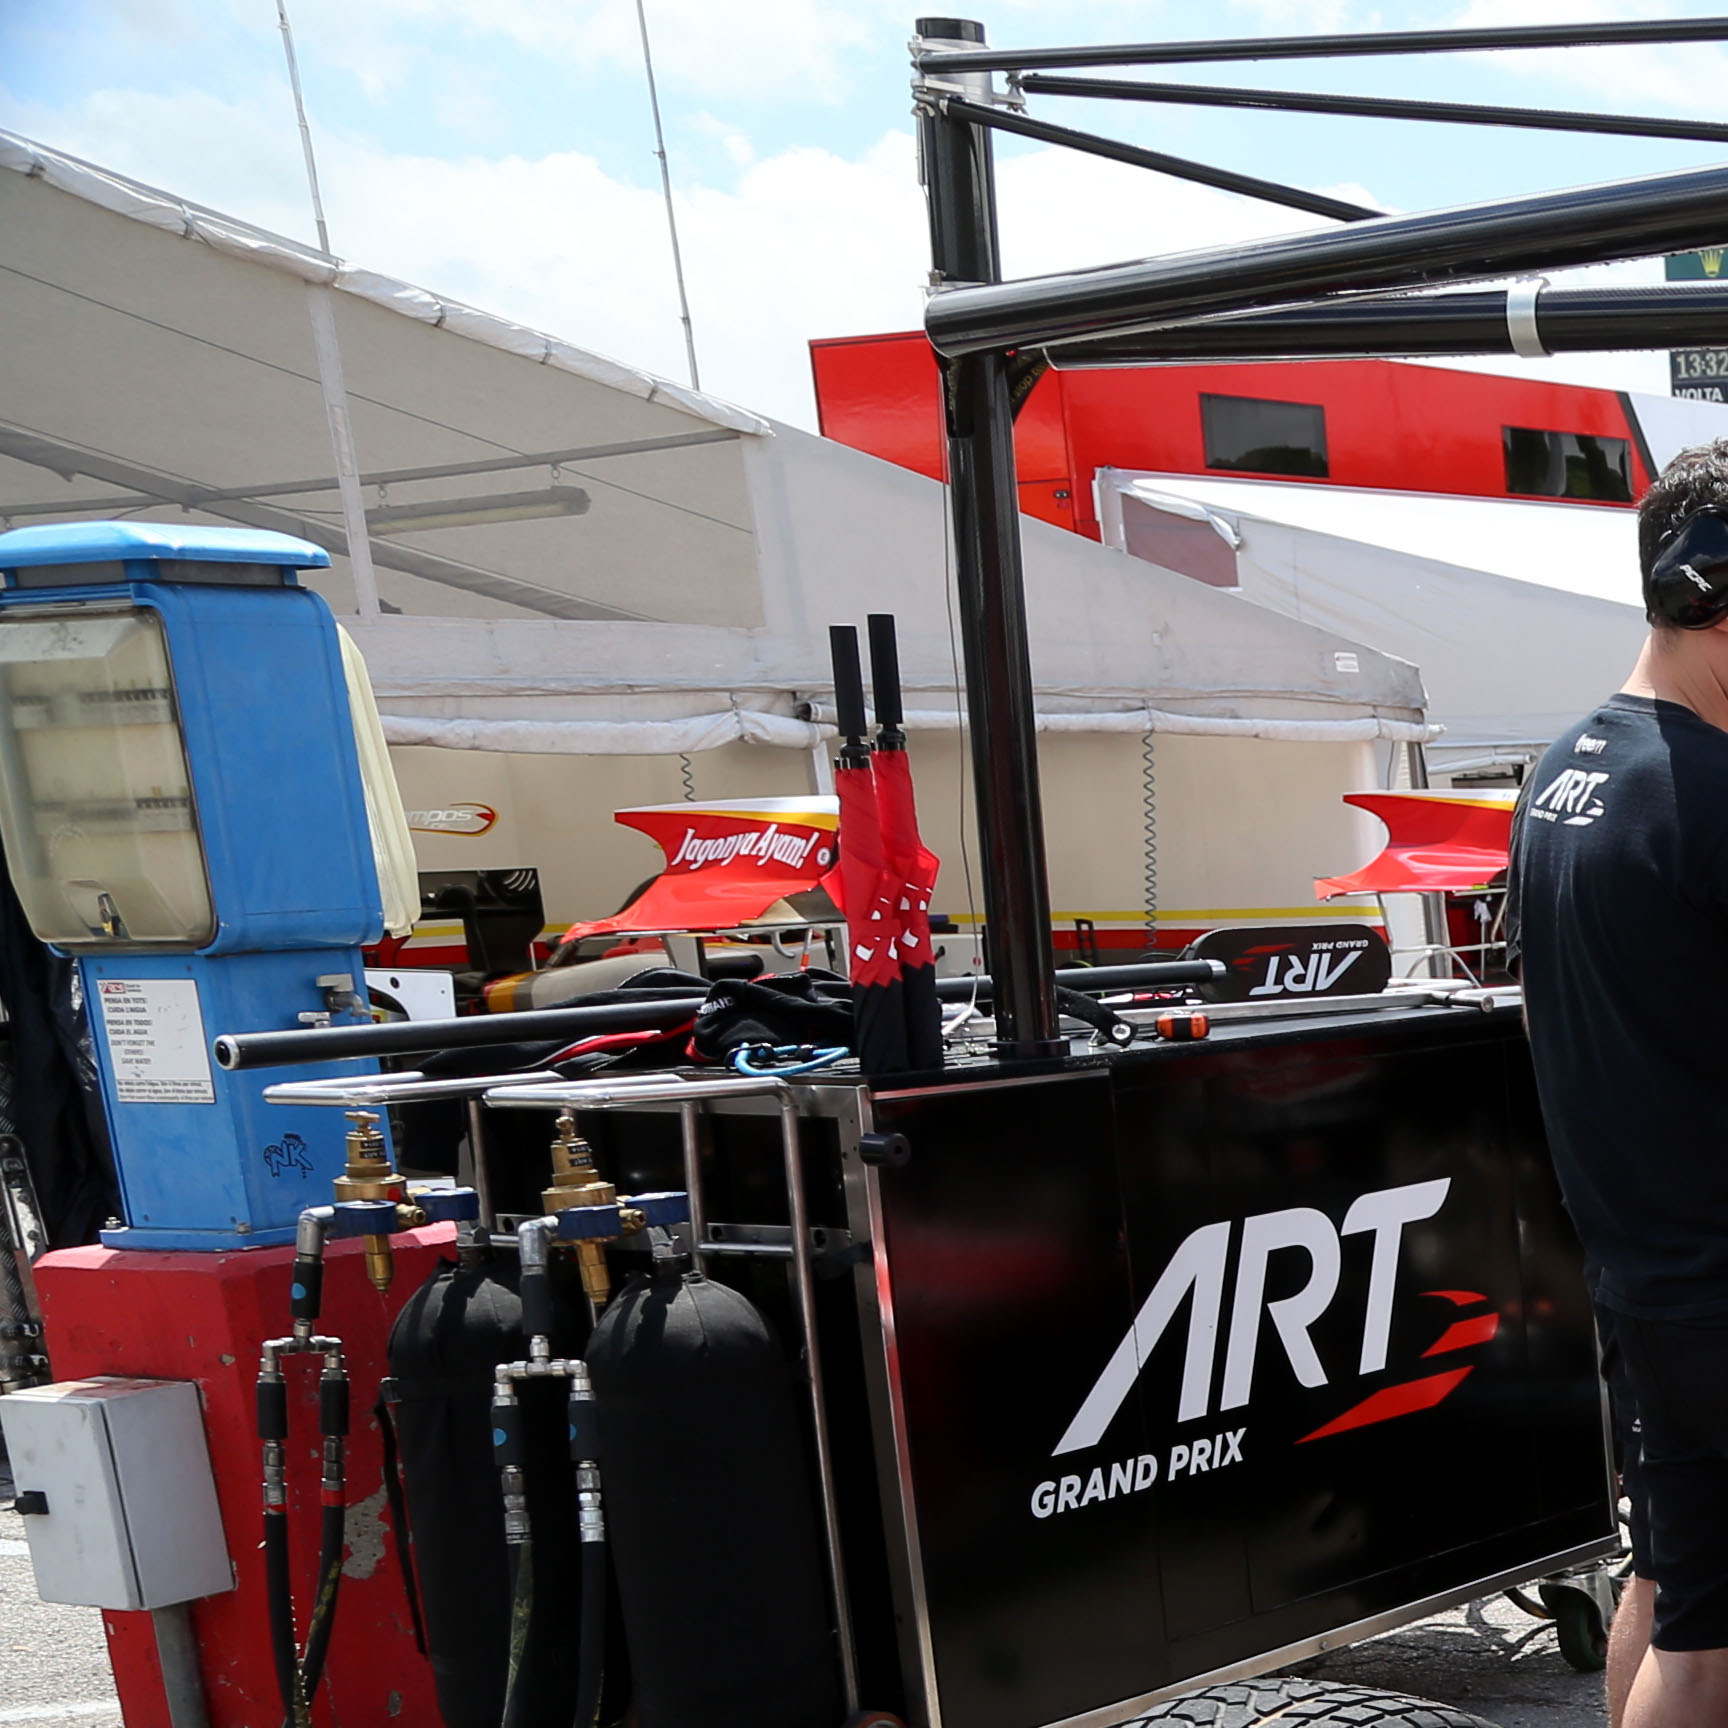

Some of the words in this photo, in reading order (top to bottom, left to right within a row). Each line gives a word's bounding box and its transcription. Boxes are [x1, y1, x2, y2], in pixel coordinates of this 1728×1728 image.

[1535, 769, 1609, 814] ART
[671, 827, 755, 871] Jagonya
[753, 823, 821, 869] Ayam!
[1249, 950, 1363, 996] ART
[1051, 1177, 1452, 1457] ART
[1030, 1453, 1158, 1519] GRAND
[1167, 1427, 1248, 1482] PRIX
